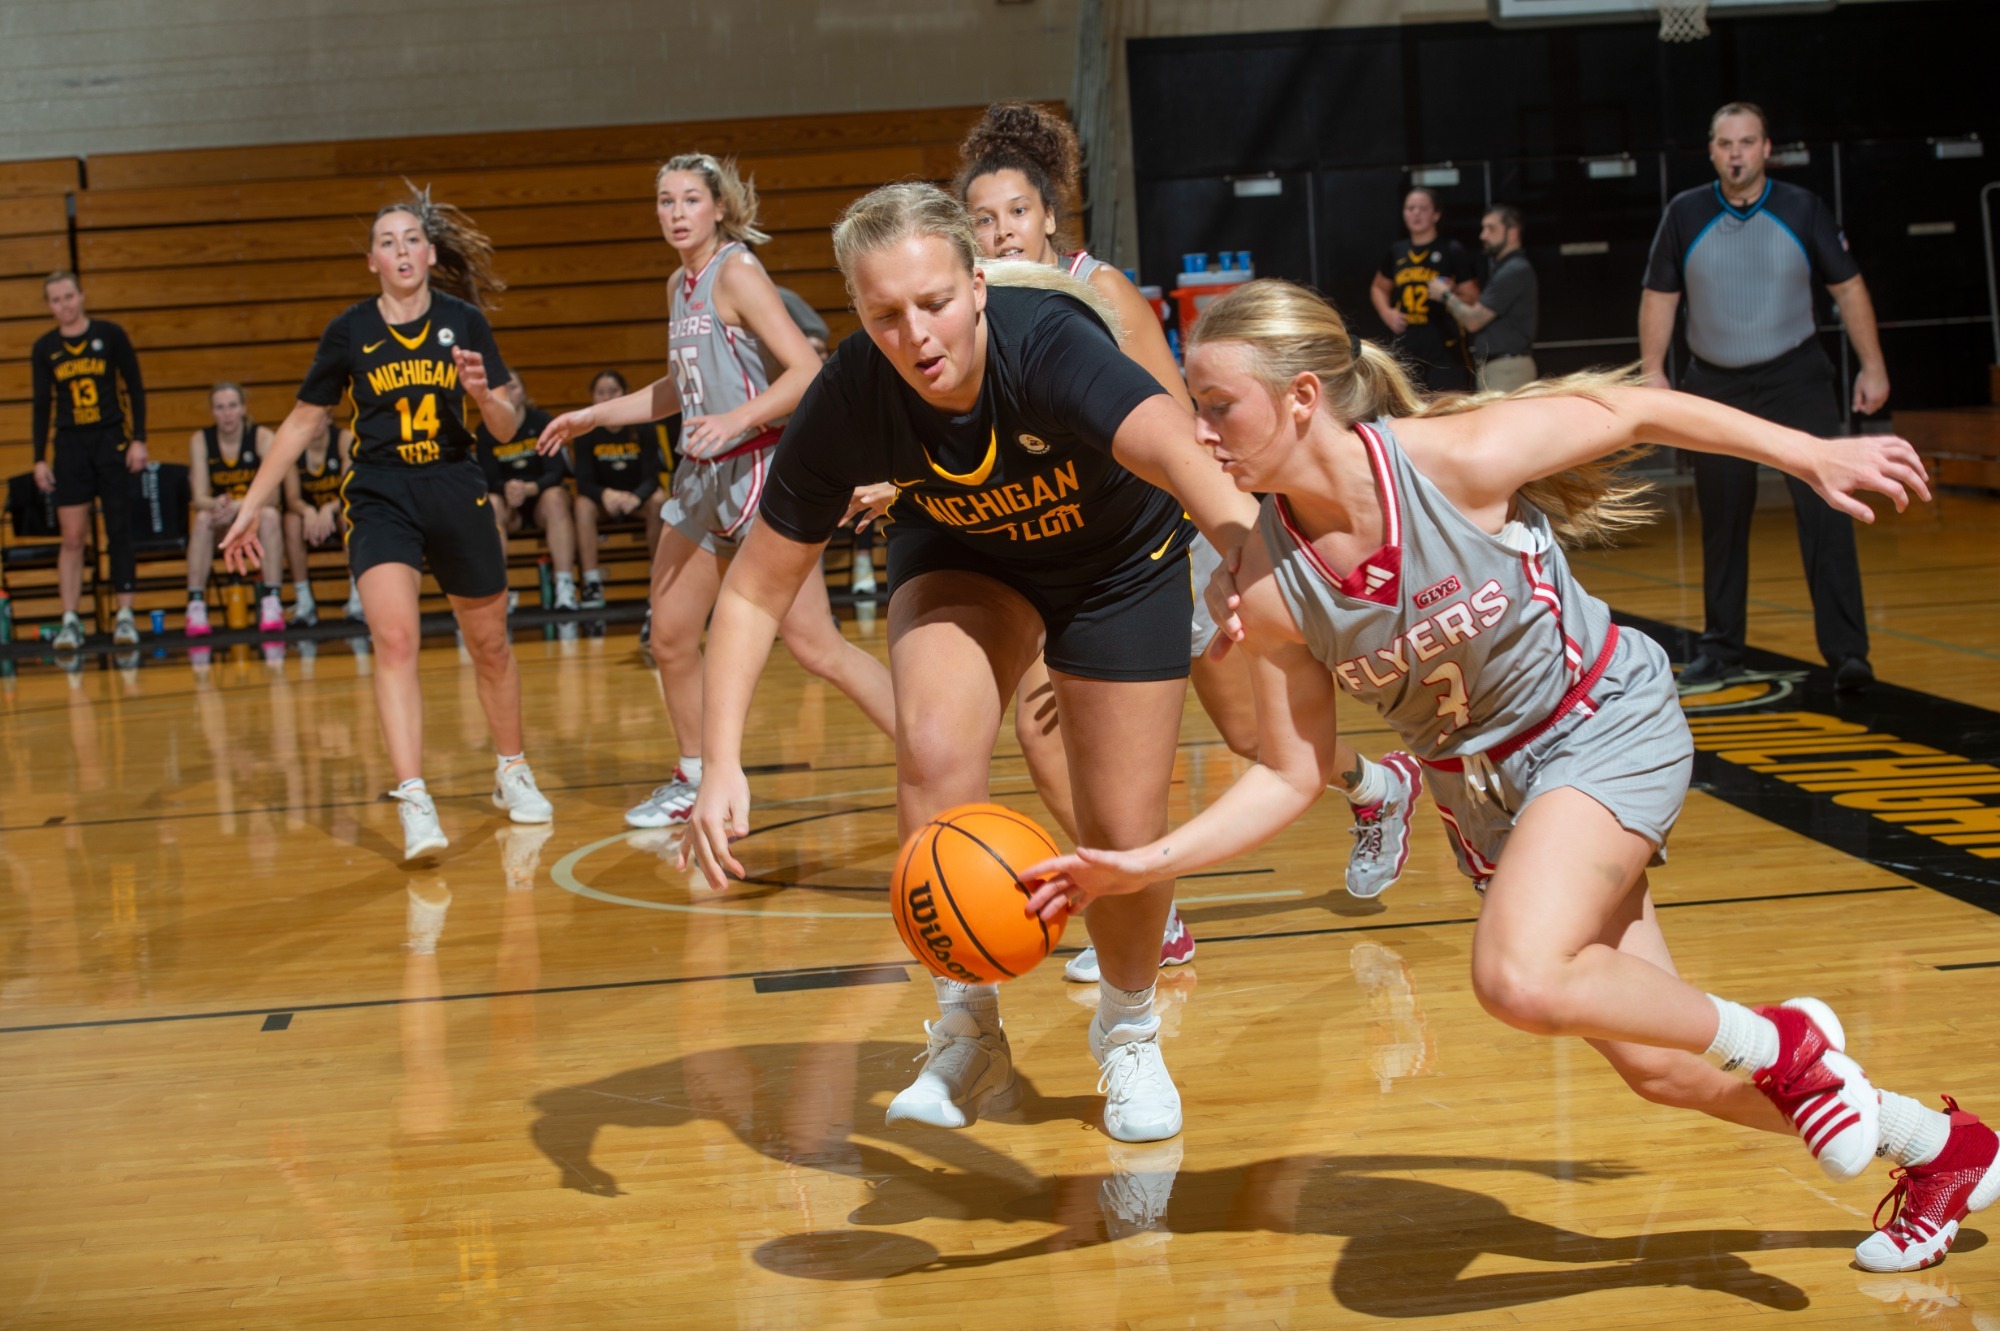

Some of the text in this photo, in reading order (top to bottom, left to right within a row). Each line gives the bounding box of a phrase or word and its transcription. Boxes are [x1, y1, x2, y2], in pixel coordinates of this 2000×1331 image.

[1402, 284, 1429, 313] 42
[69, 377, 98, 408] 13
[367, 359, 459, 396] MICHIGAN
[395, 393, 440, 441] 14
[396, 440, 440, 464] TECH
[914, 460, 1080, 527] MICHIGAN
[1417, 577, 1458, 607] GLVC
[1336, 579, 1510, 692] FLYERS
[908, 880, 984, 984] Wilson
